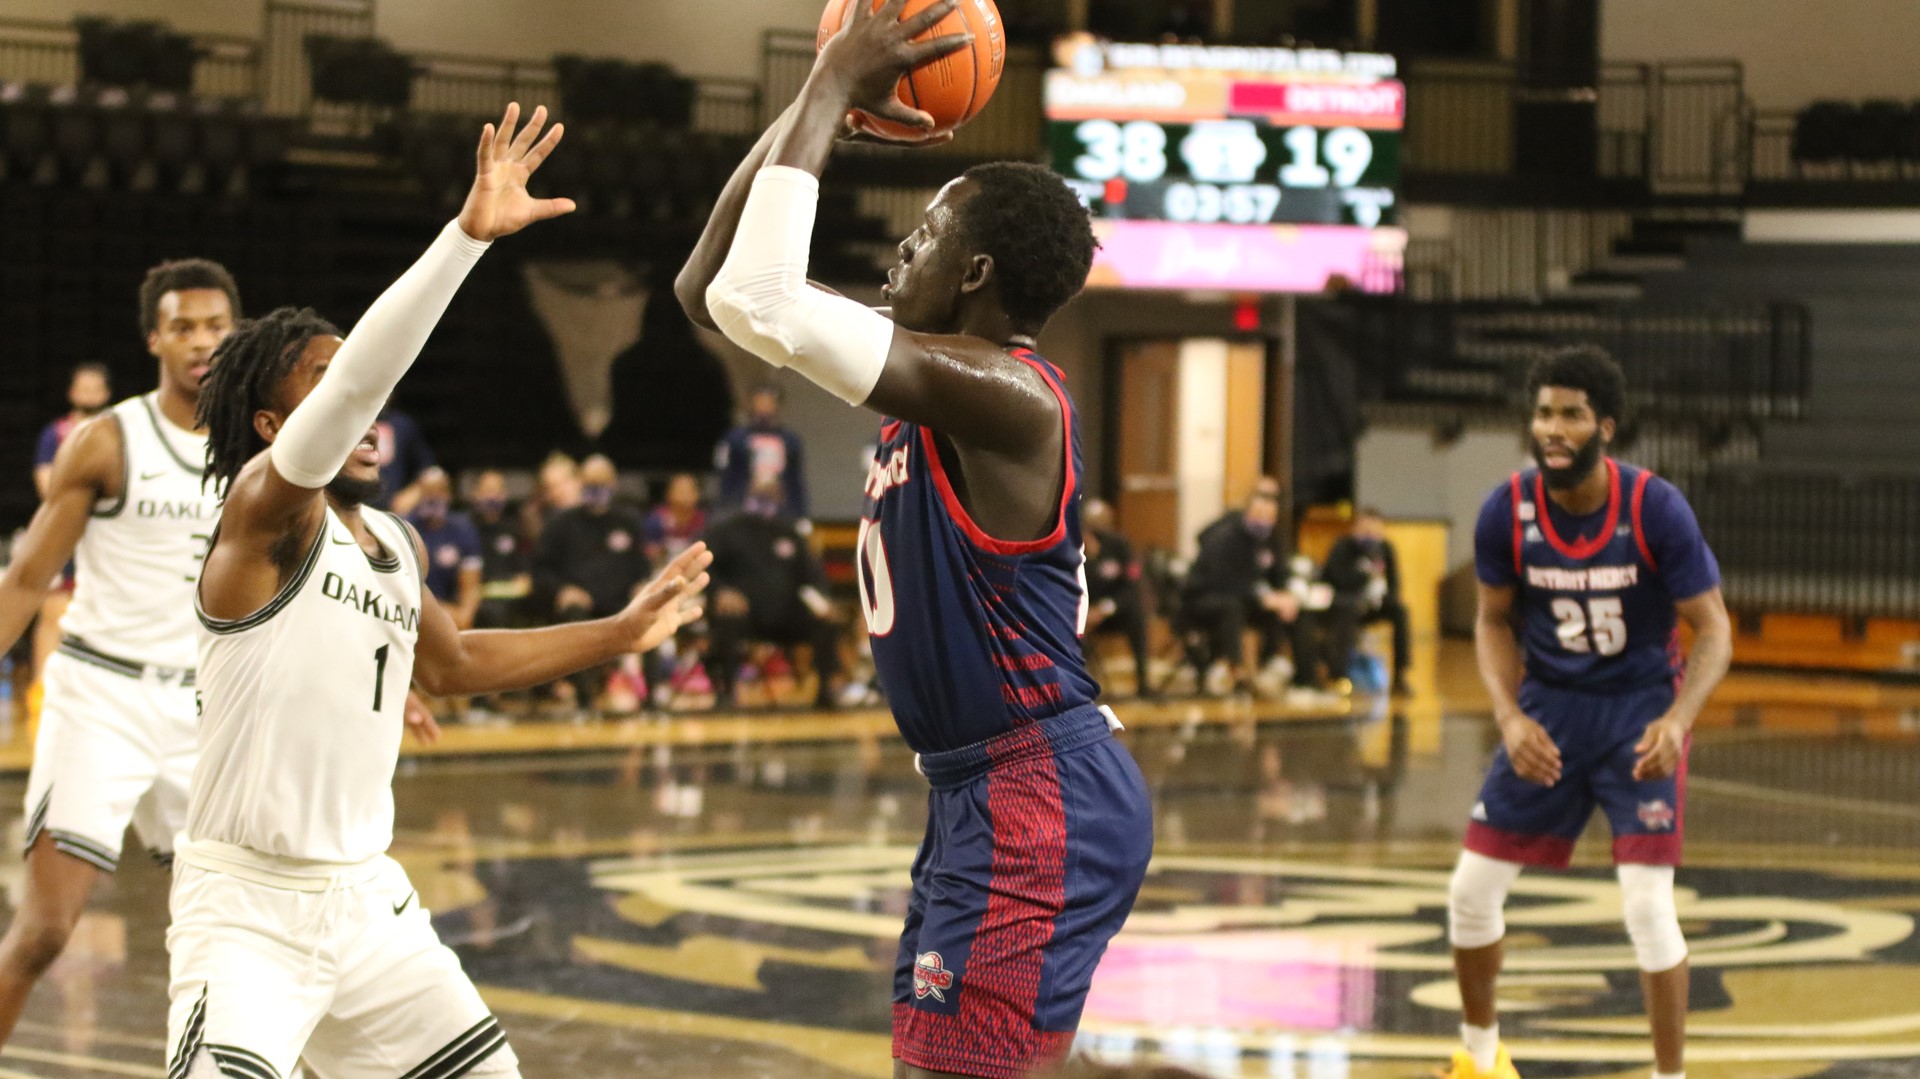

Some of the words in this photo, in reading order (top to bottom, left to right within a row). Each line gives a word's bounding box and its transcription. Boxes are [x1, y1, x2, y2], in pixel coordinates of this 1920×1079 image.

[1287, 87, 1397, 113] DETROIT
[1075, 119, 1167, 181] 38
[1279, 125, 1373, 187] 19
[1551, 596, 1627, 656] 25
[372, 642, 389, 712] 1
